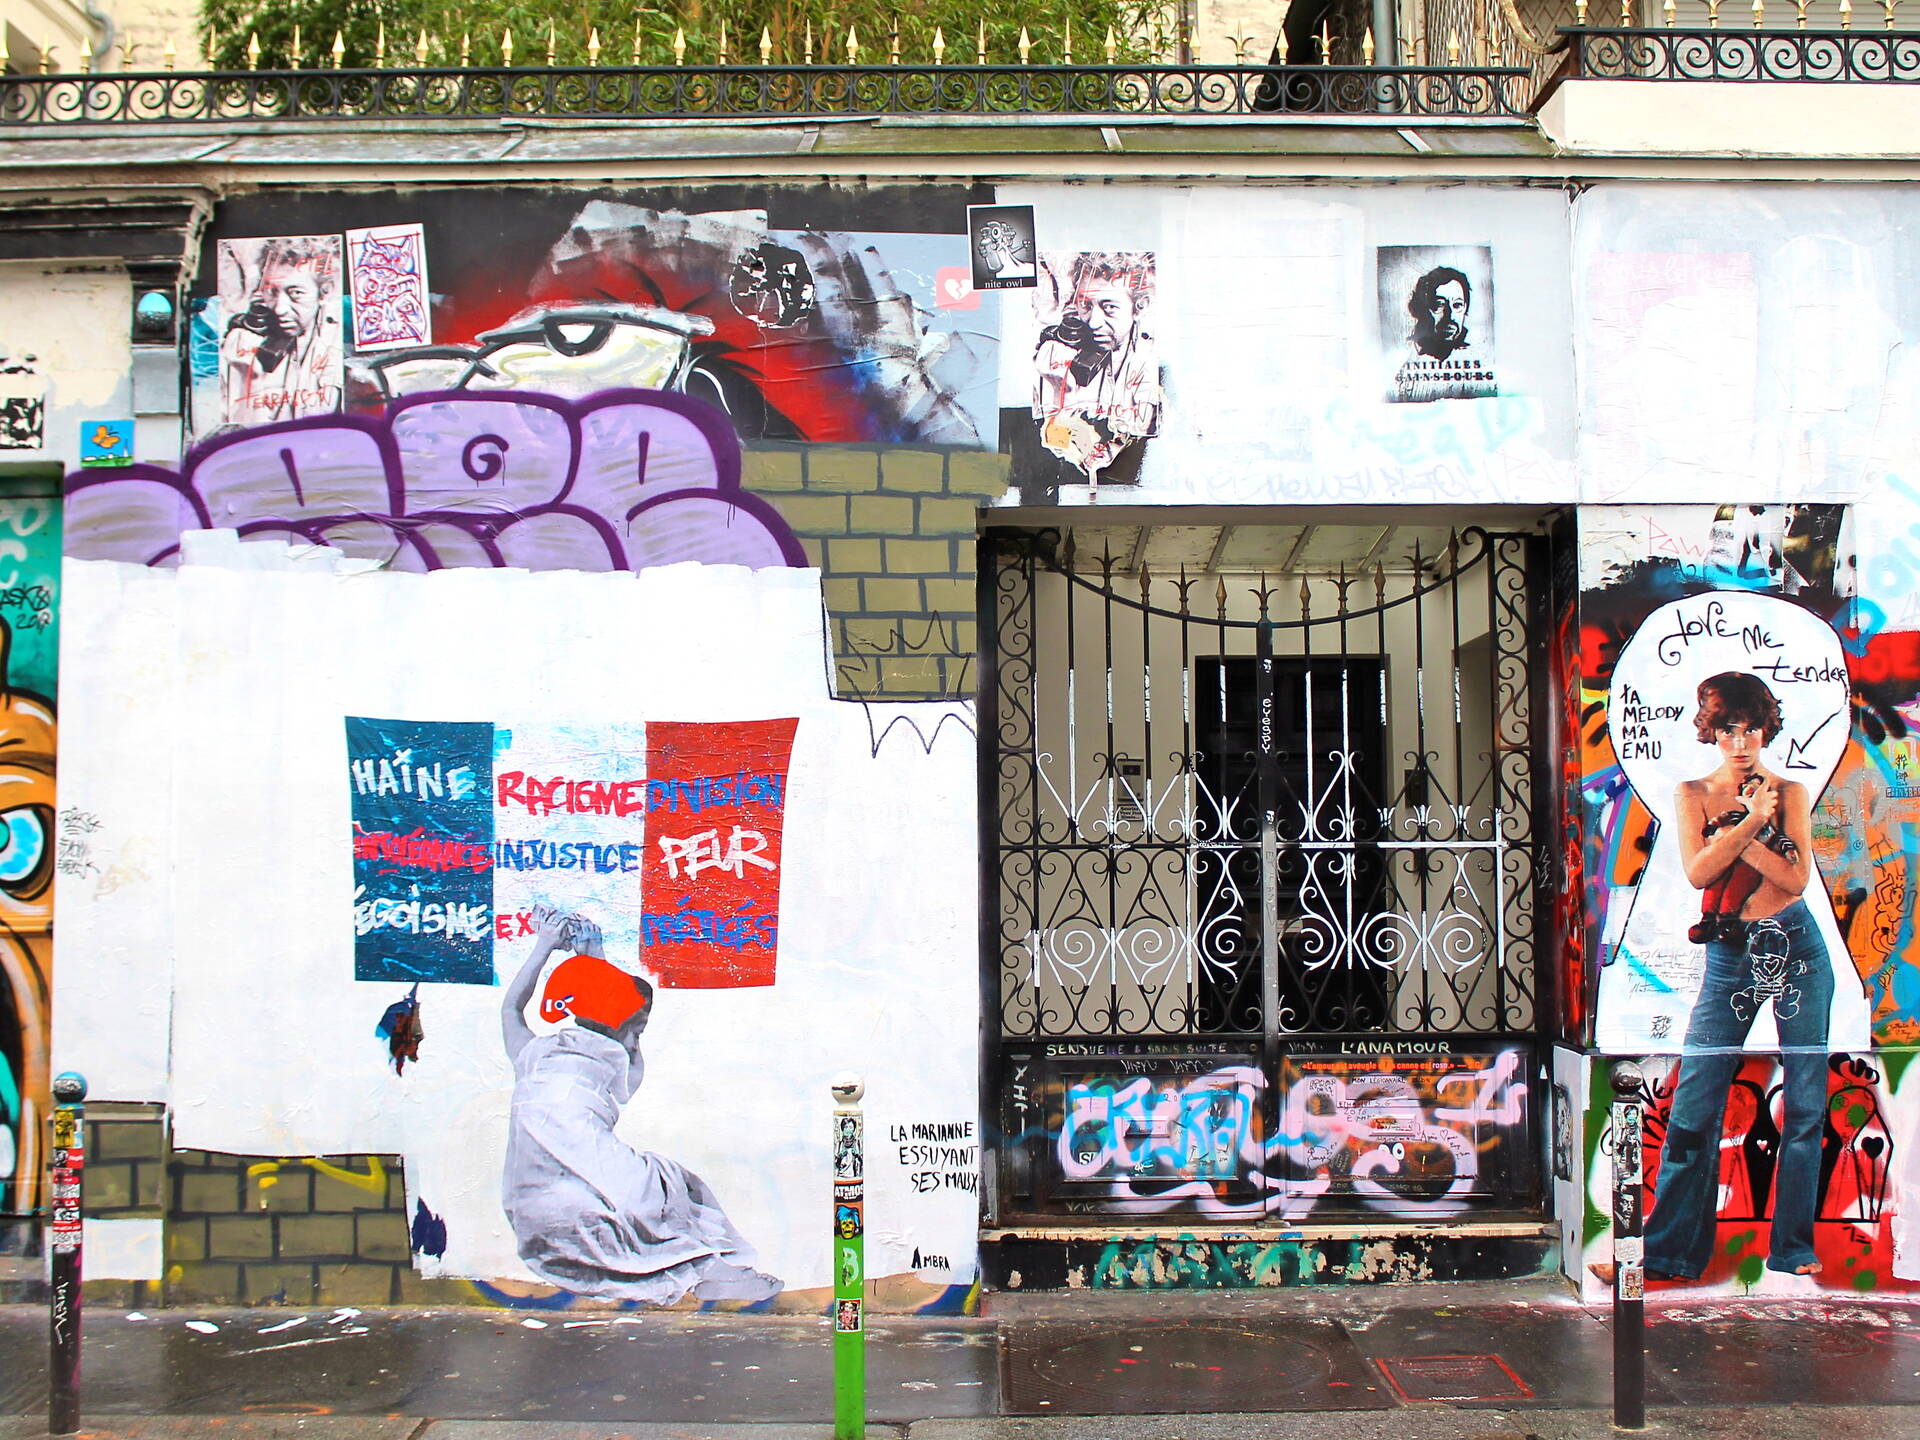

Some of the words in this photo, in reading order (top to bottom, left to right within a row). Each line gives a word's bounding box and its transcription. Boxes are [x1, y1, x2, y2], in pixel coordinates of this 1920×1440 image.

[985, 280, 1001, 289] nite
[1006, 279, 1023, 288] owl
[1407, 360, 1481, 370] INITIALES
[1623, 705, 1684, 723] MELODY
[648, 770, 781, 813] DIVISION
[496, 838, 641, 873] INJUSTICE
[658, 825, 776, 880] PEUR
[1186, 1043, 1227, 1054] SUITE
[1341, 1041, 1452, 1054] L'ANAMOUR
[891, 1125, 907, 1142] LA
[912, 1121, 974, 1143] MARIANNE
[899, 1145, 978, 1171] ESSUYANT
[911, 1171, 940, 1193] SES
[945, 1172, 978, 1197] MAUX
